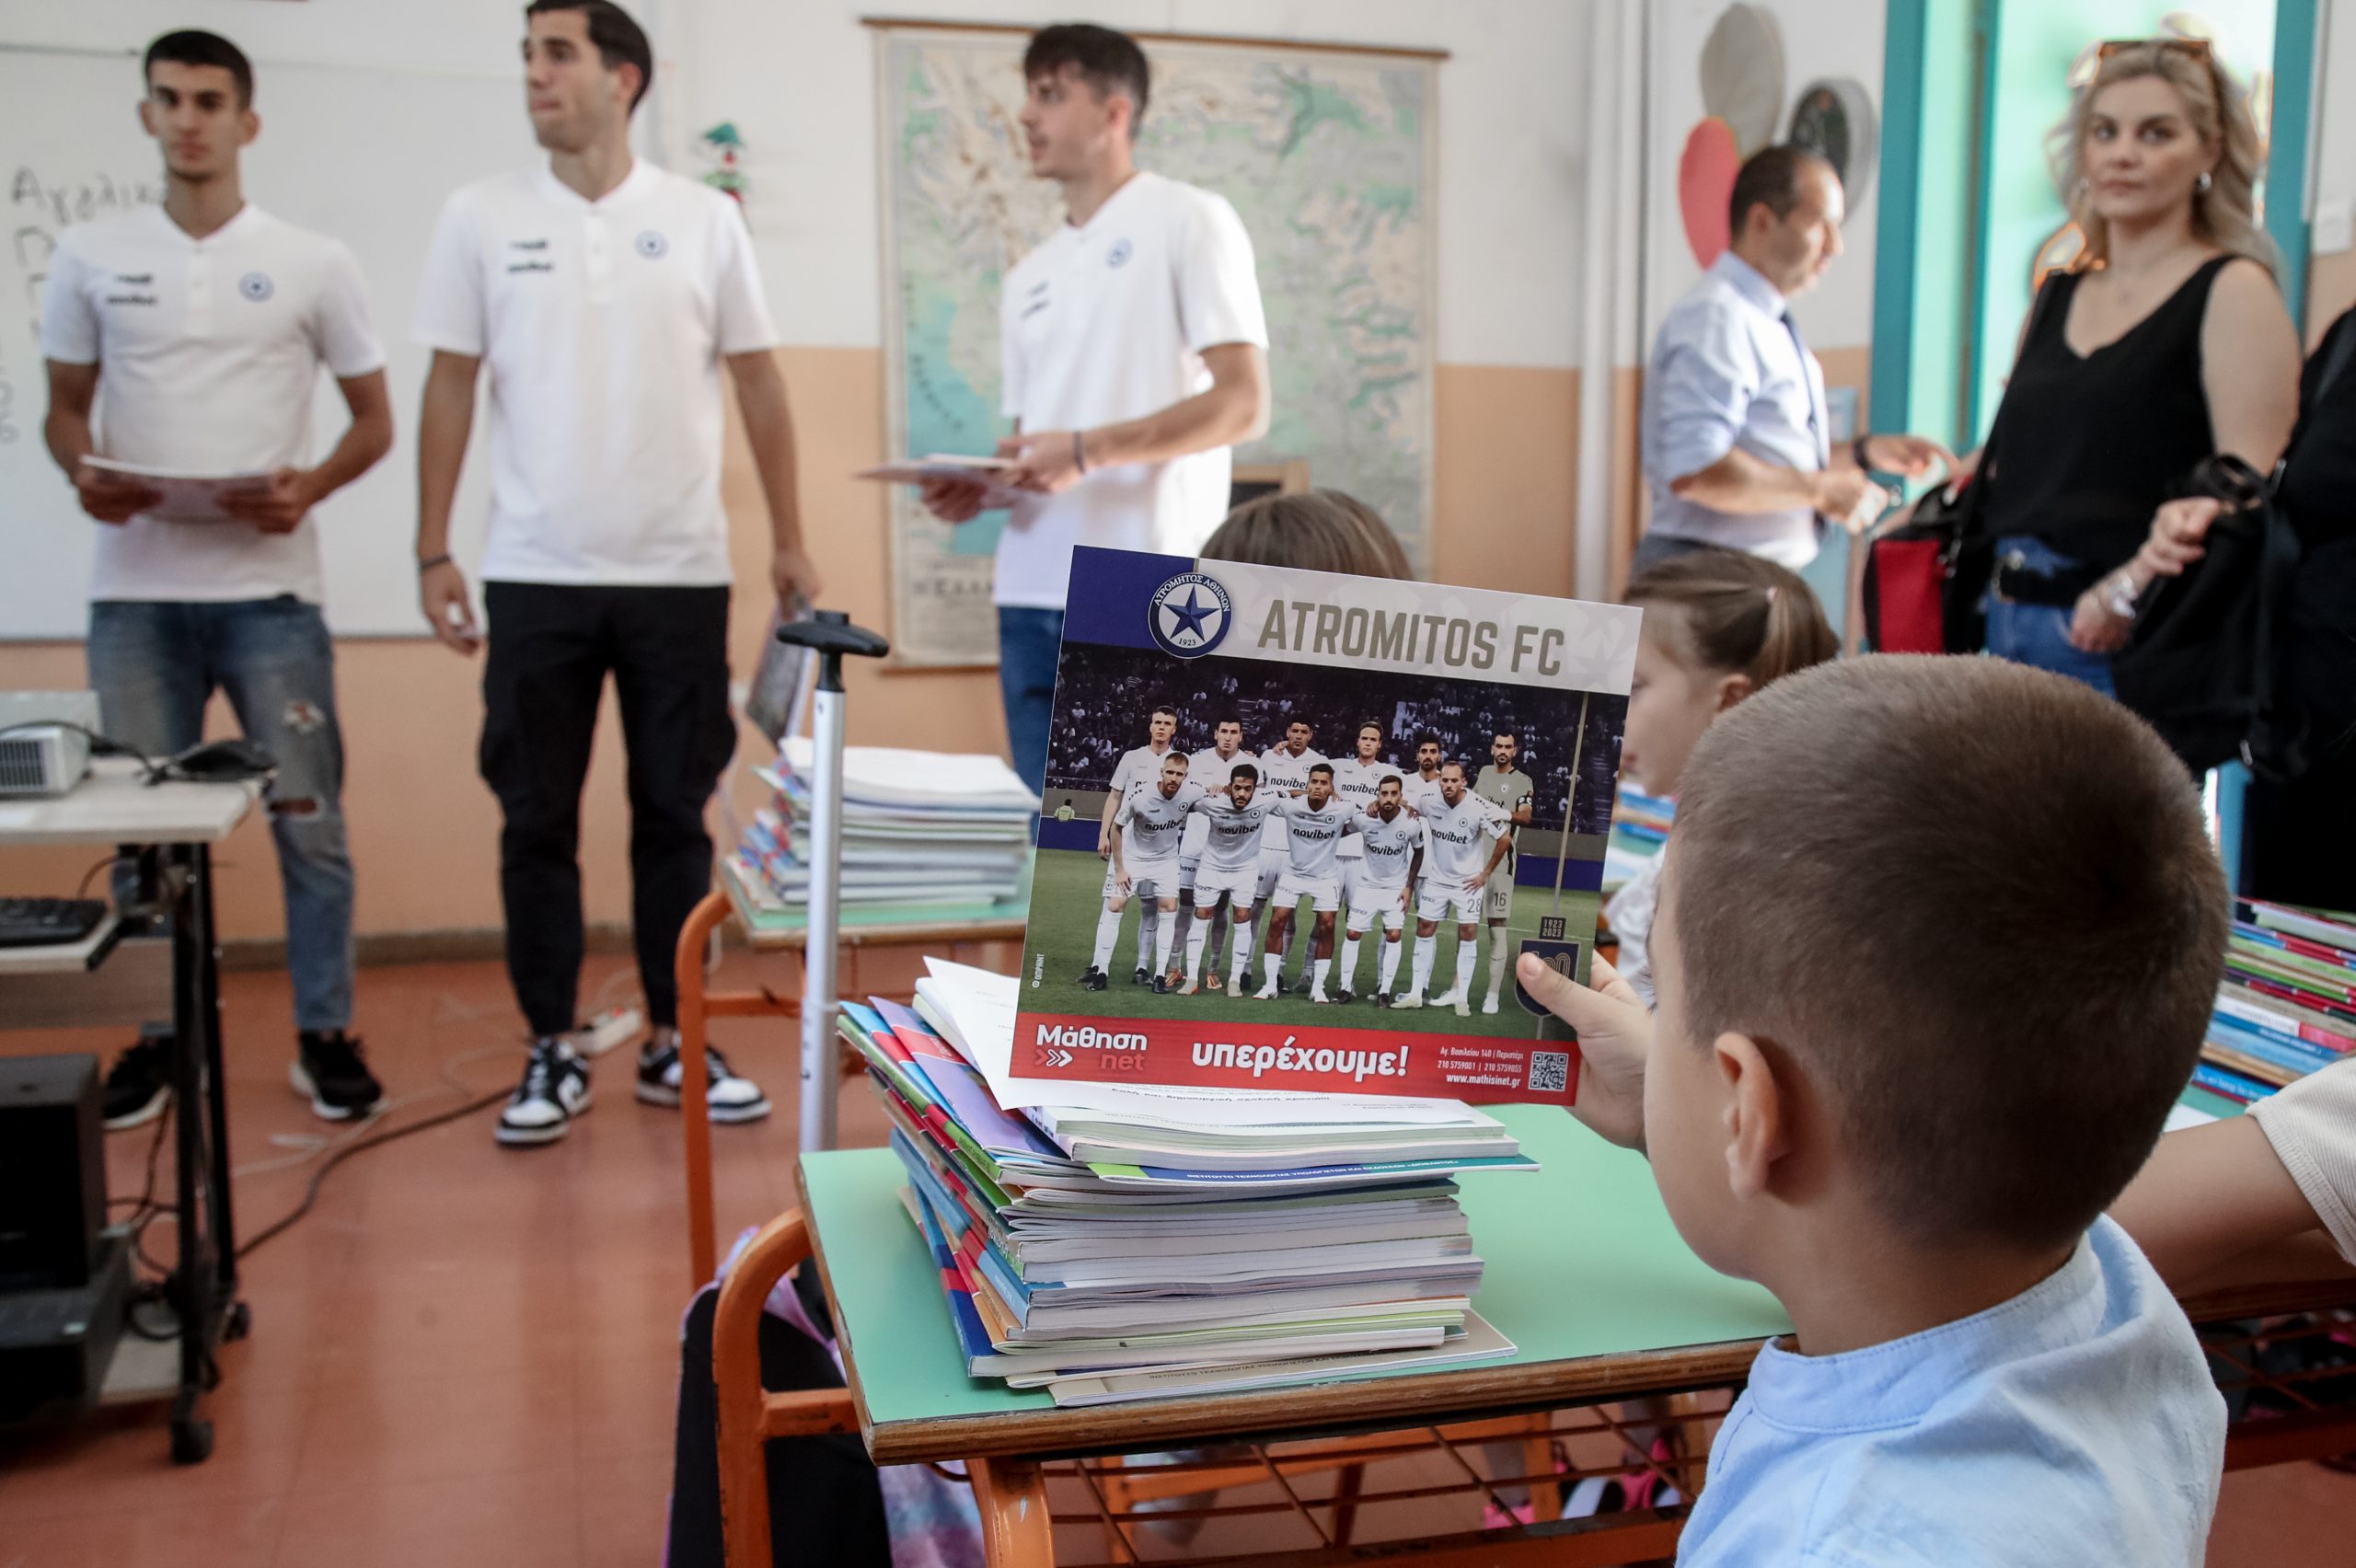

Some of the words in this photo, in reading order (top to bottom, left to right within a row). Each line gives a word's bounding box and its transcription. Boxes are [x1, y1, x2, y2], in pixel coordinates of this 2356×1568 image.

[1153, 574, 1204, 607] ΑΤΡΟΜΗΤΟΣ
[1203, 578, 1230, 614] ΑΘΗΝΩΝ
[1178, 637, 1197, 647] 1923
[1257, 599, 1498, 670] ATROMITOS
[1510, 624, 1565, 676] FC
[1293, 827, 1336, 839] novibet
[1432, 828, 1468, 845] novibet
[1367, 842, 1403, 857] novibet
[1467, 898, 1482, 914] 28
[1494, 892, 1507, 907] 16
[1543, 919, 1564, 928] 1923
[1542, 928, 1562, 938] 2023
[1036, 1024, 1148, 1050] Μάθηση
[1101, 1053, 1145, 1070] net
[1192, 1035, 1409, 1082] υπερέχουμε!
[1438, 1060, 1449, 1069] 210
[1484, 1062, 1496, 1071] 210
[1447, 1074, 1521, 1088] www.mathisinet.gr
